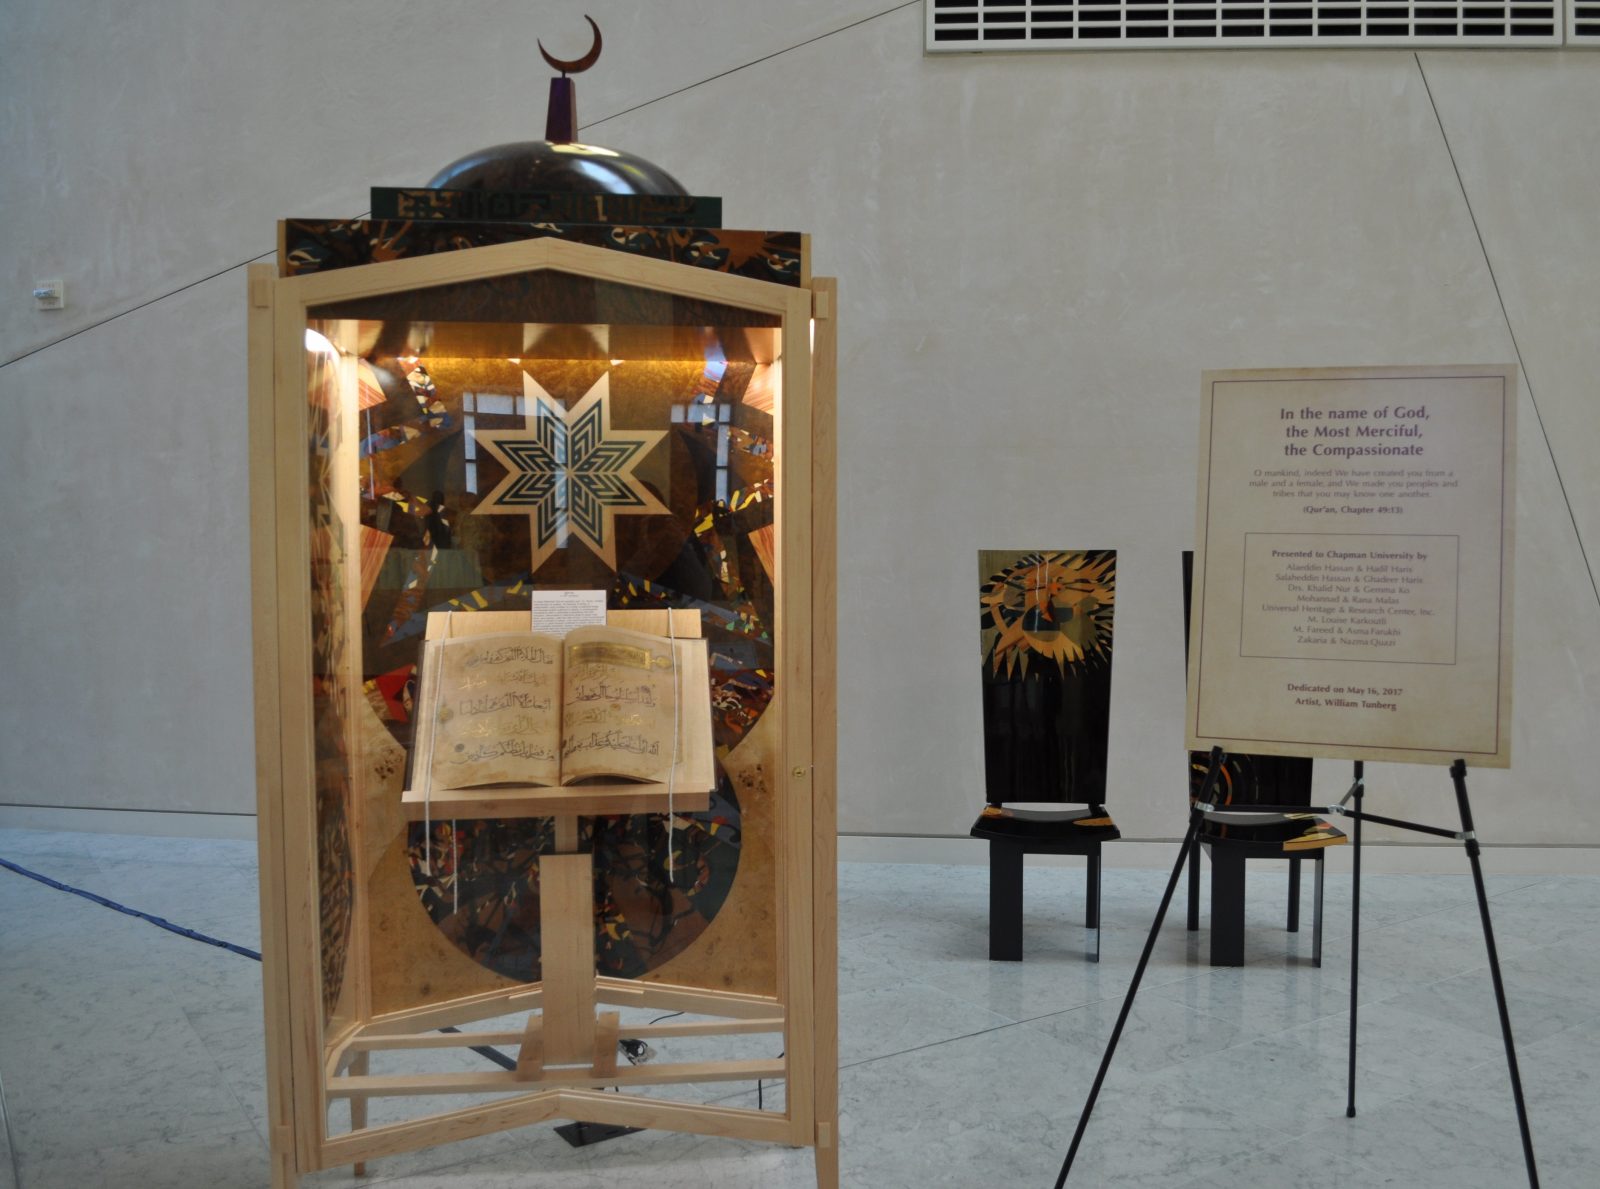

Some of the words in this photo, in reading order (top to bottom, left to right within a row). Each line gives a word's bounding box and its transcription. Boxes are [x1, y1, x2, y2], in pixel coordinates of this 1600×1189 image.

[1280, 408, 1294, 419] In
[1300, 408, 1322, 419] the
[1328, 410, 1367, 419] name
[1374, 406, 1389, 419] of
[1394, 406, 1430, 420] God,
[1286, 426, 1308, 437] the
[1314, 426, 1350, 437] Most
[1356, 425, 1422, 438] Merciful,
[1284, 444, 1306, 456] the
[1313, 444, 1423, 459] Compassionate
[1265, 469, 1301, 477] mankind,
[1406, 480, 1439, 489] peoples
[1341, 506, 1374, 514] Chapter
[1327, 552, 1366, 560] Chapman
[1370, 552, 1413, 560] University
[1417, 552, 1427, 561] by
[1302, 606, 1336, 614] Heritage
[1297, 636, 1326, 644] Zakaria
[1288, 684, 1330, 692] Dedicated
[1347, 686, 1364, 695] May
[1324, 699, 1358, 707] William
[1361, 700, 1396, 711] Tunberg
